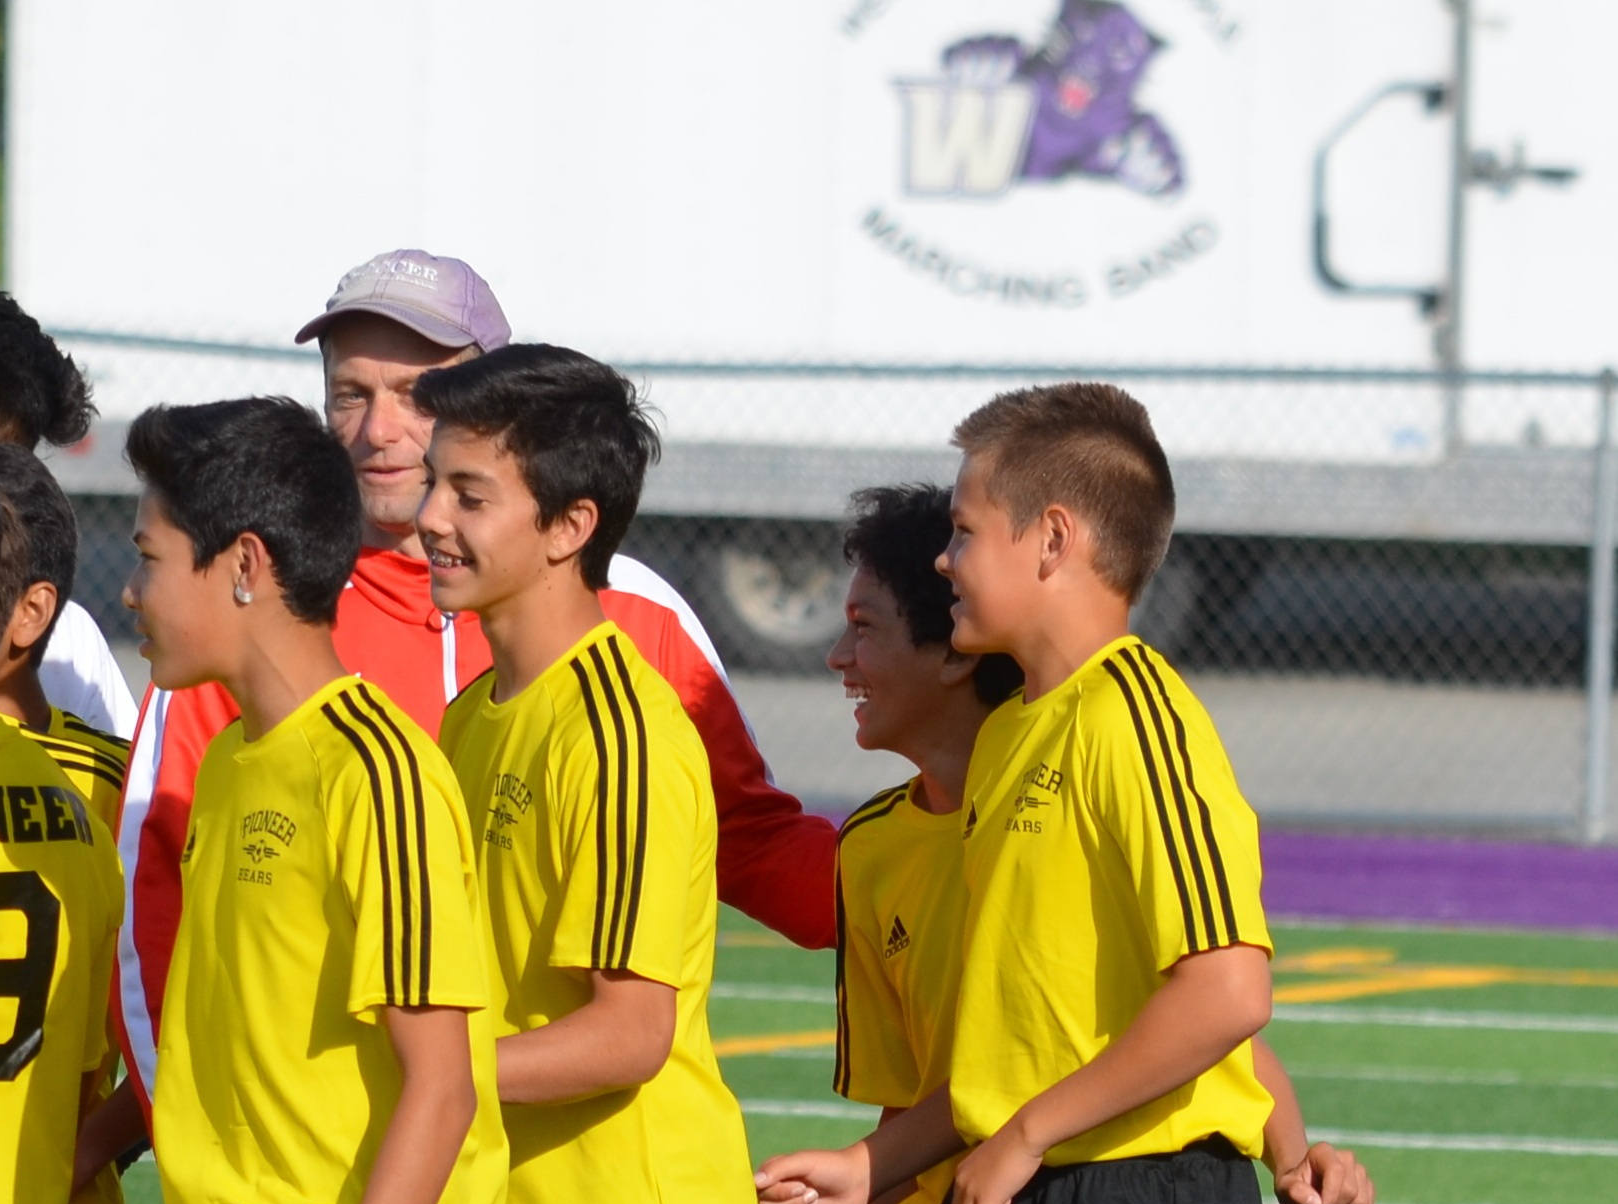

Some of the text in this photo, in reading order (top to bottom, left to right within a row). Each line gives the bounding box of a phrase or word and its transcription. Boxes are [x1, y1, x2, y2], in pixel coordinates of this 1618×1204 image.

[862, 209, 1218, 304] MARCHING BAND
[494, 773, 533, 815] IONEER
[241, 809, 297, 848] PIONEER
[237, 867, 273, 886] BEARS
